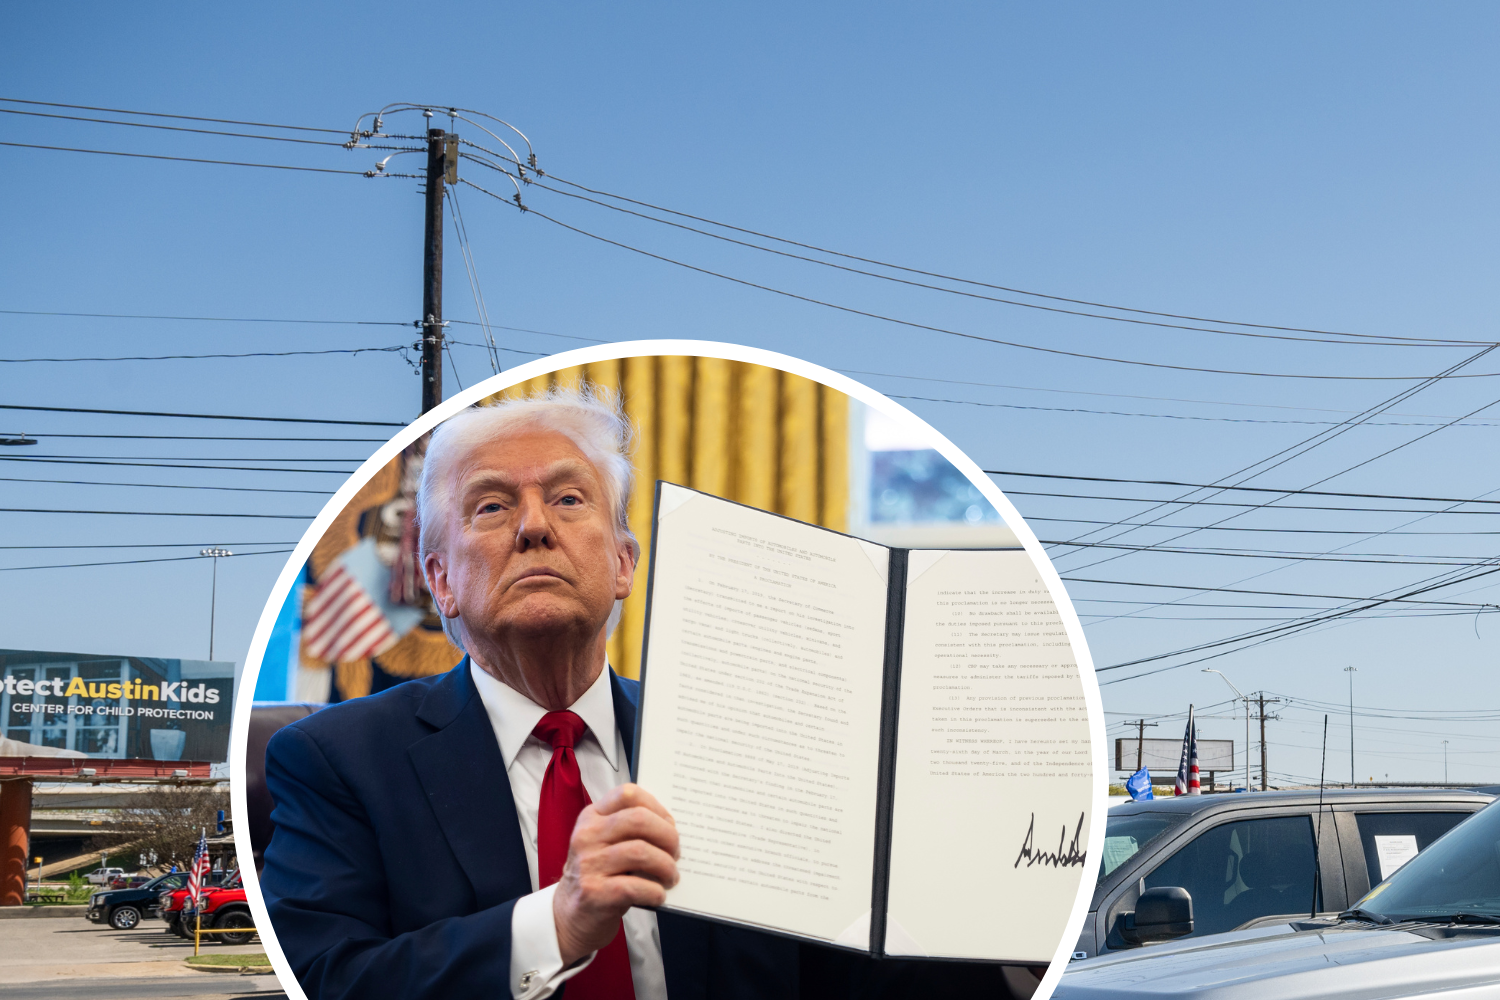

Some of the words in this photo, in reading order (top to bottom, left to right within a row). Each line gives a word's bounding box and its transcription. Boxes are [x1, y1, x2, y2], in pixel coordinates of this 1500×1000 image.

[0, 675, 220, 704] tectAustinKids
[12, 703, 63, 714] CENTER
[67, 705, 93, 715] FOR
[96, 706, 135, 716] CHILD
[137, 707, 214, 720] PROTECTION
